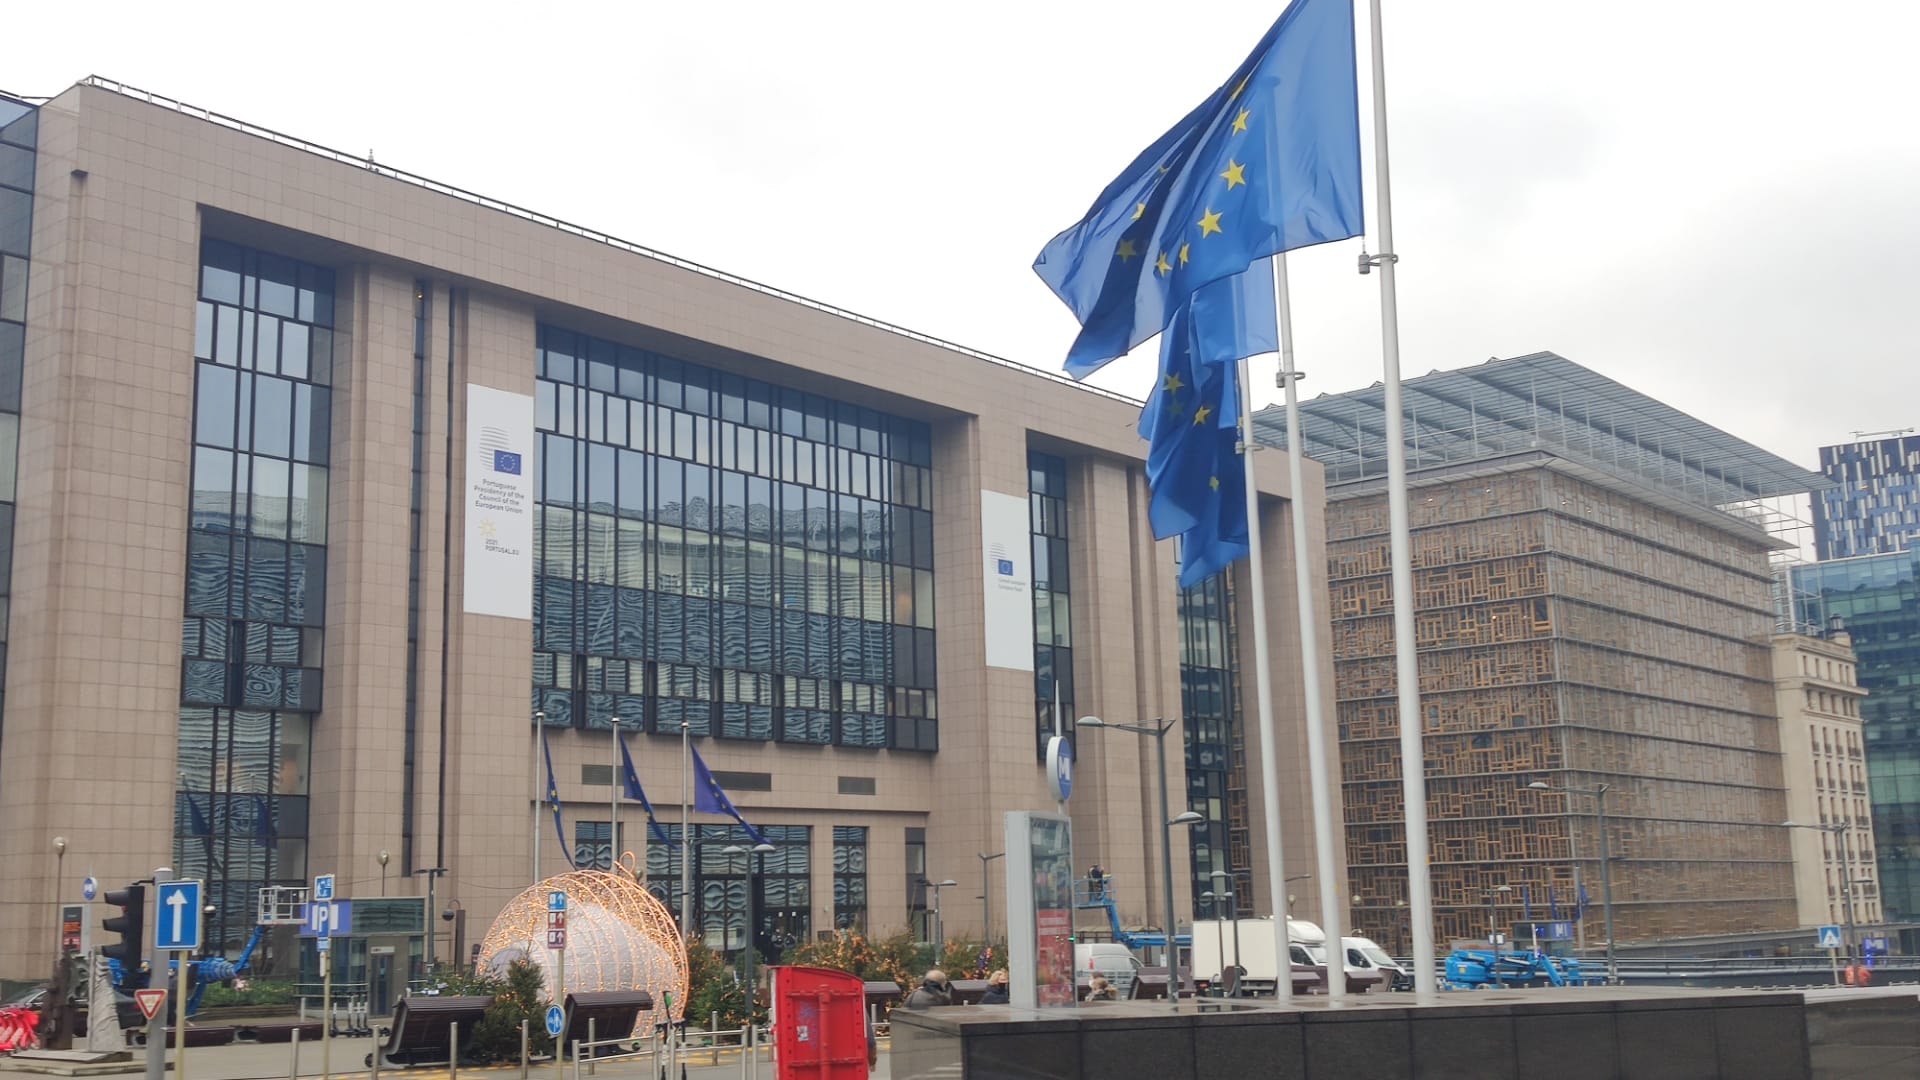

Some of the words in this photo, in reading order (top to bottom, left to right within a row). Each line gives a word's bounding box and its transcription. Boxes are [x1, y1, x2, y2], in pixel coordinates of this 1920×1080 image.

[474, 485, 506, 497] Presidency
[479, 493, 501, 502] Council
[475, 500, 504, 511] European
[505, 505, 523, 514] Union
[319, 906, 328, 932] P
